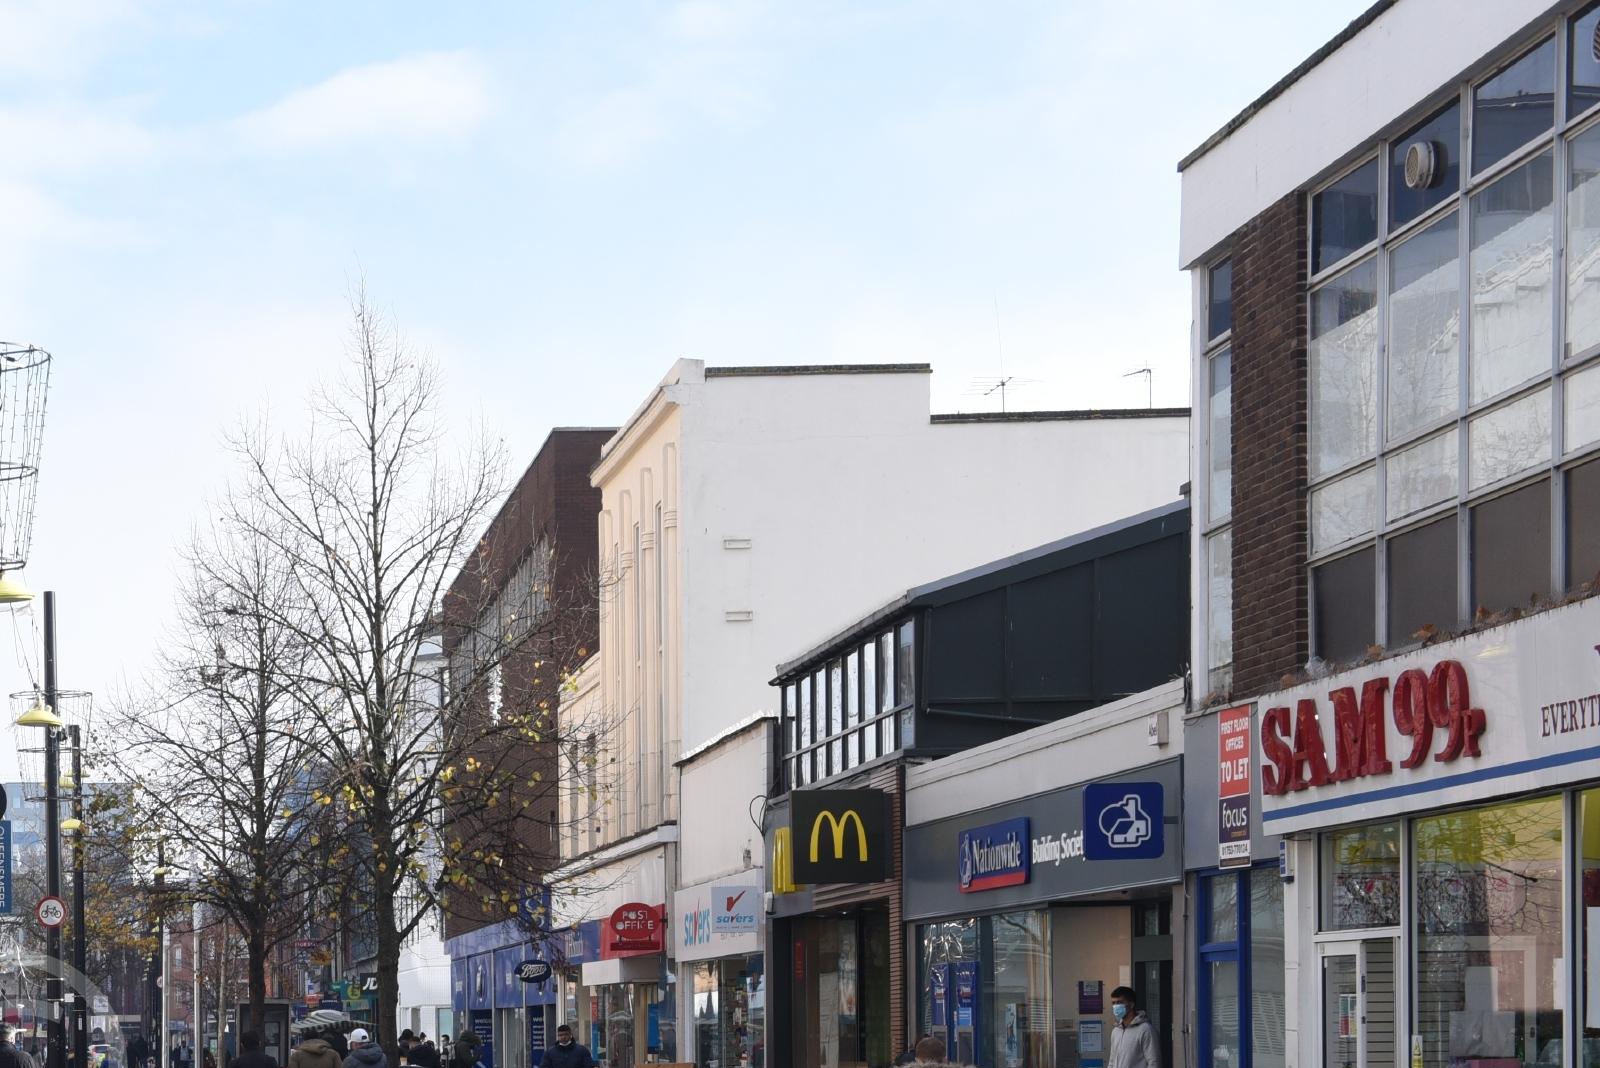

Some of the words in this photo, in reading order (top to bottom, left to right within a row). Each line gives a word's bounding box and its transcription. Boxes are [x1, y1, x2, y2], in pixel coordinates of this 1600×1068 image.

[1541, 693, 1600, 738] EVERYT
[1261, 677, 1392, 796] SAM
[1221, 761, 1232, 782] TO
[1233, 757, 1249, 781] LET
[1222, 802, 1247, 829] focus
[972, 831, 1021, 875] Nationwide
[1032, 835, 1060, 866] Building
[1061, 830, 1086, 862] Societ
[615, 920, 654, 930] OFFICE
[622, 910, 648, 920] POST
[716, 913, 754, 923] savers
[521, 963, 548, 978] Boots
